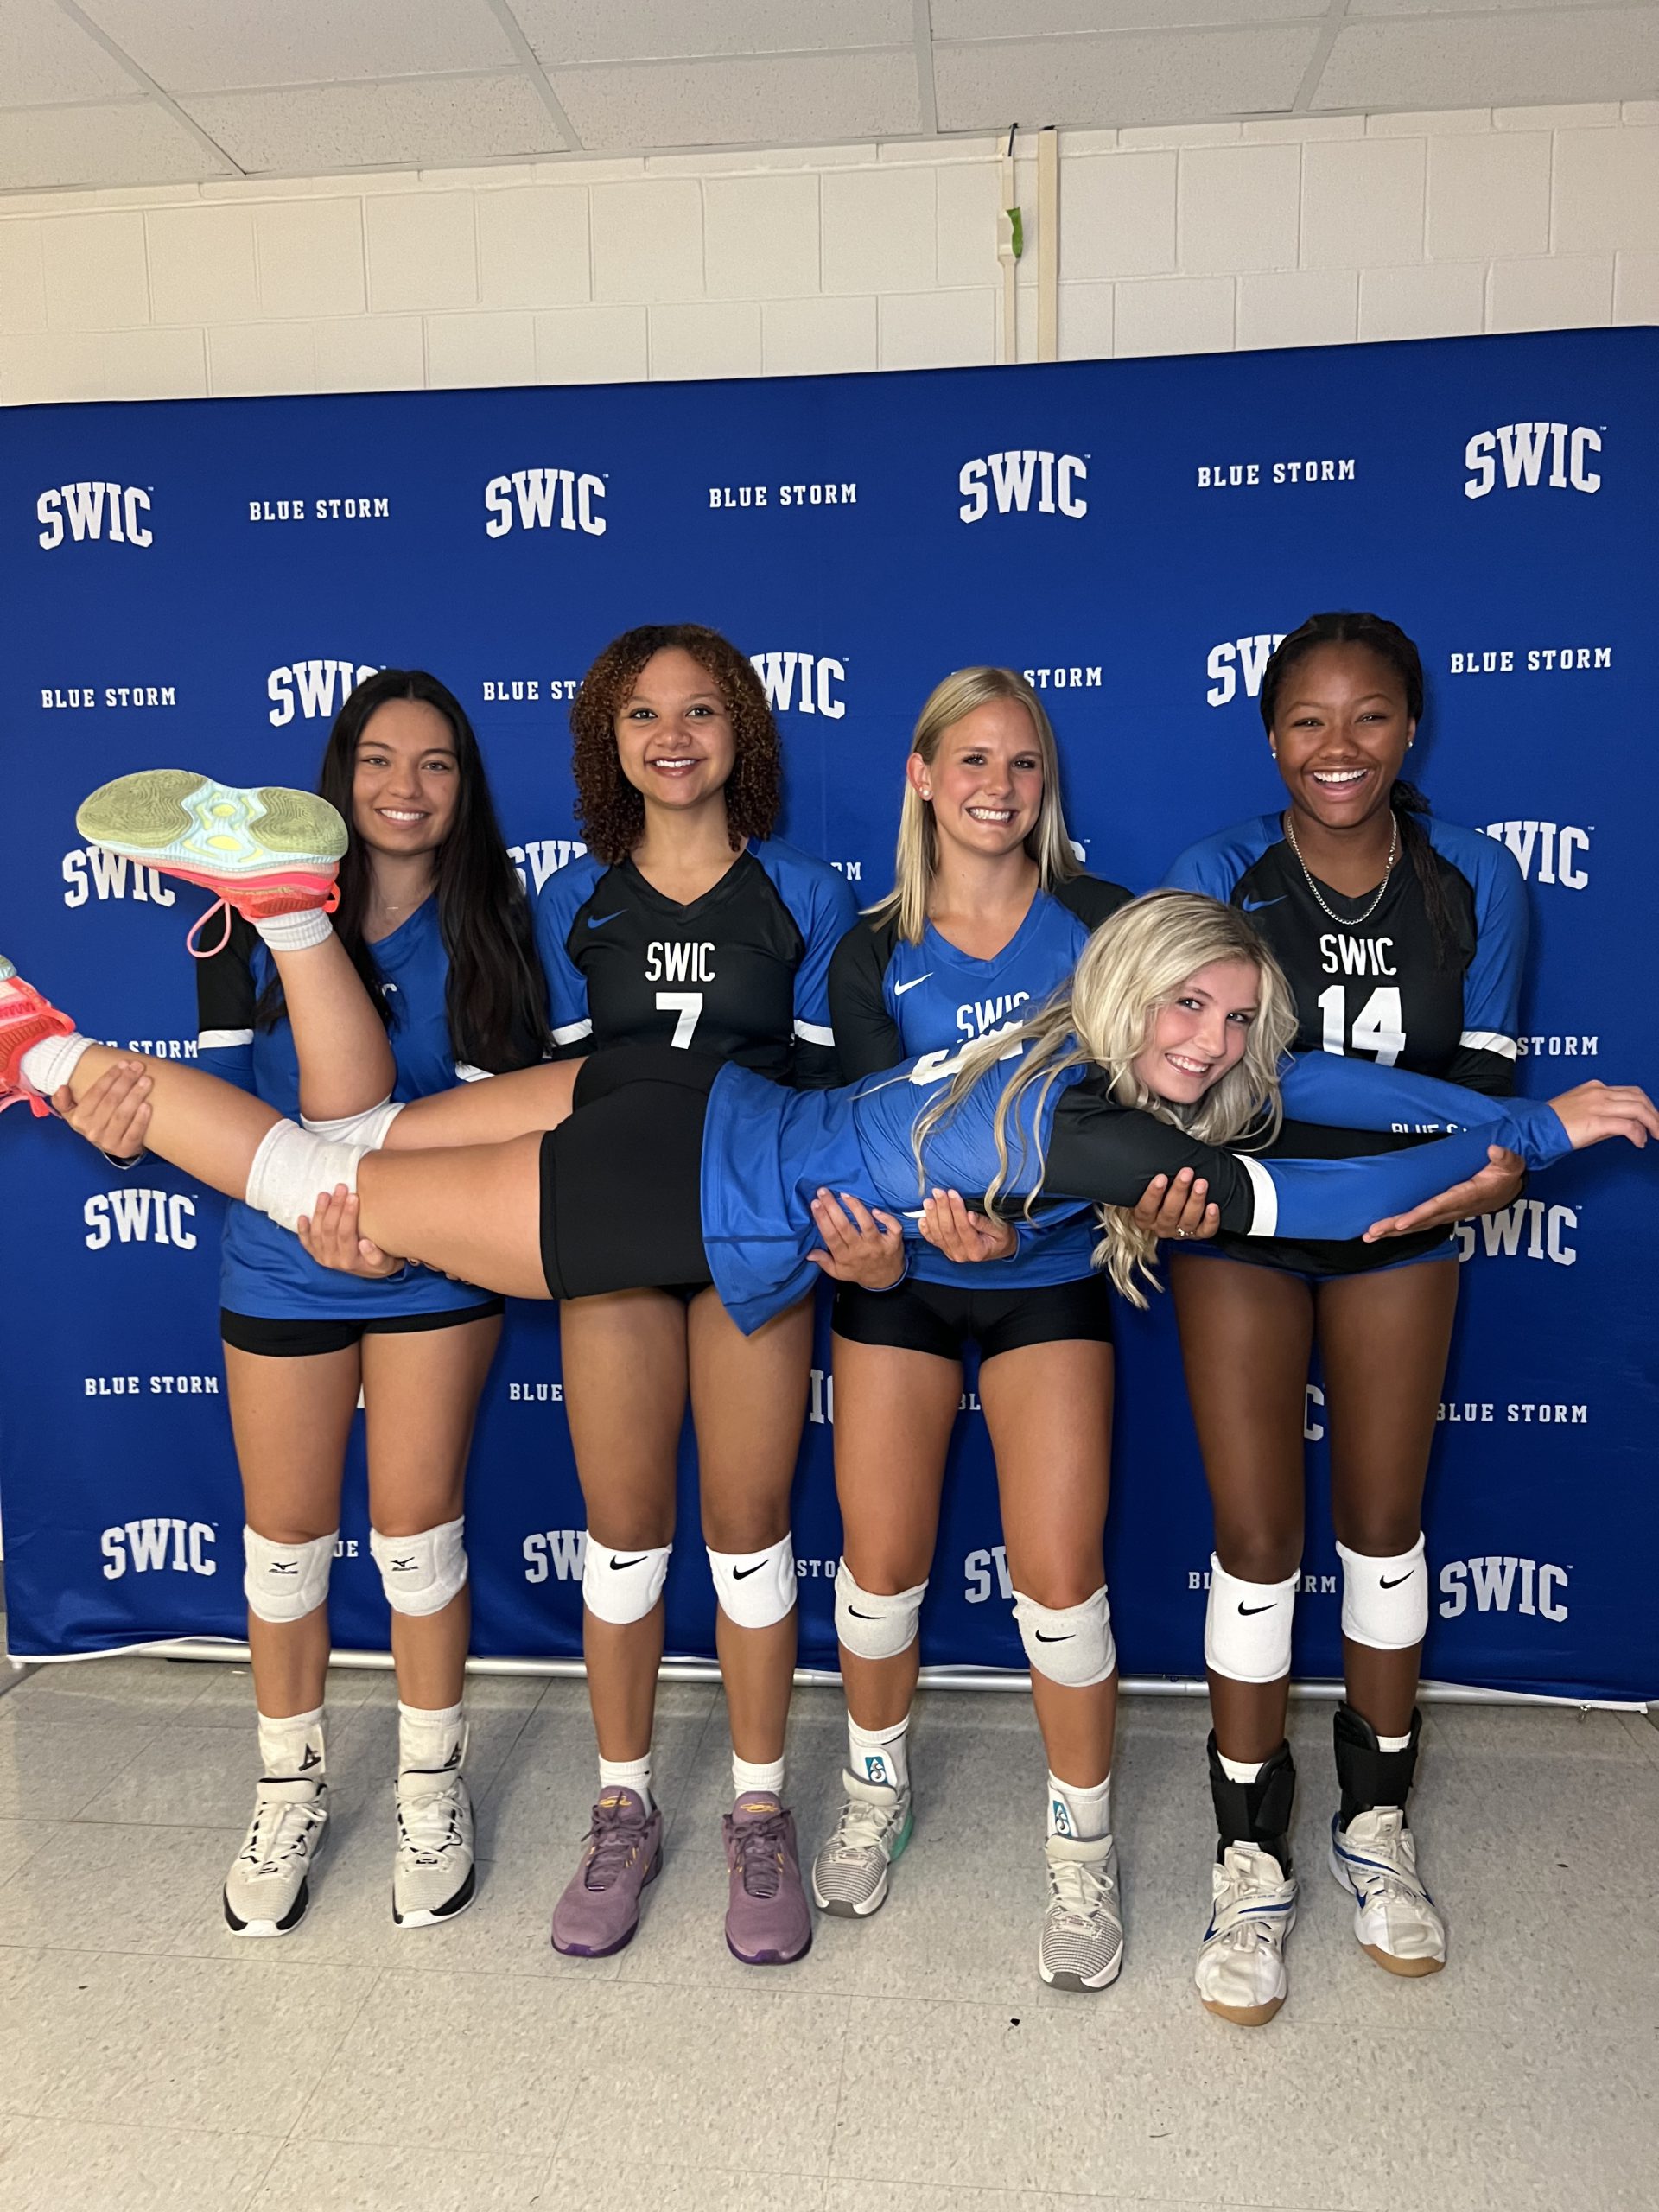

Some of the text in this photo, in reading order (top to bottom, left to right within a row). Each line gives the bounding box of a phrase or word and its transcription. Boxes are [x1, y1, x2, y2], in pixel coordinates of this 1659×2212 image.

[1198, 459, 1356, 487] BLUE STORM
[1465, 422, 1602, 499] SWIC
[249, 498, 390, 521] BLUE STORM
[485, 467, 607, 539] SWIC
[709, 484, 858, 508] BLUE STORM
[959, 450, 1088, 524] SWIC
[36, 481, 154, 550] SWIC
[1023, 666, 1102, 689] STORM
[1206, 633, 1288, 708] SW
[1450, 647, 1612, 674] BLUE STORM
[41, 686, 176, 709] BLUE STORM
[482, 681, 539, 701] BLUE
[748, 652, 846, 720] WIC
[62, 845, 175, 908] SWIC
[1474, 820, 1591, 891] WIC
[645, 942, 715, 982] SWIC
[1319, 933, 1397, 976] SWIC
[655, 991, 703, 1050] 7
[1317, 984, 1407, 1067] 14
[128, 1039, 198, 1058] STORM
[1516, 1036, 1599, 1056] STORM
[83, 1188, 197, 1250] SWIC
[85, 1376, 219, 1396] BLUE STORM
[509, 1382, 563, 1402] BLUE
[1436, 1403, 1588, 1424] BLUE STORM
[101, 1517, 217, 1580] SWIC
[522, 1529, 588, 1584] SW
[1439, 1555, 1568, 1623] SWIC
